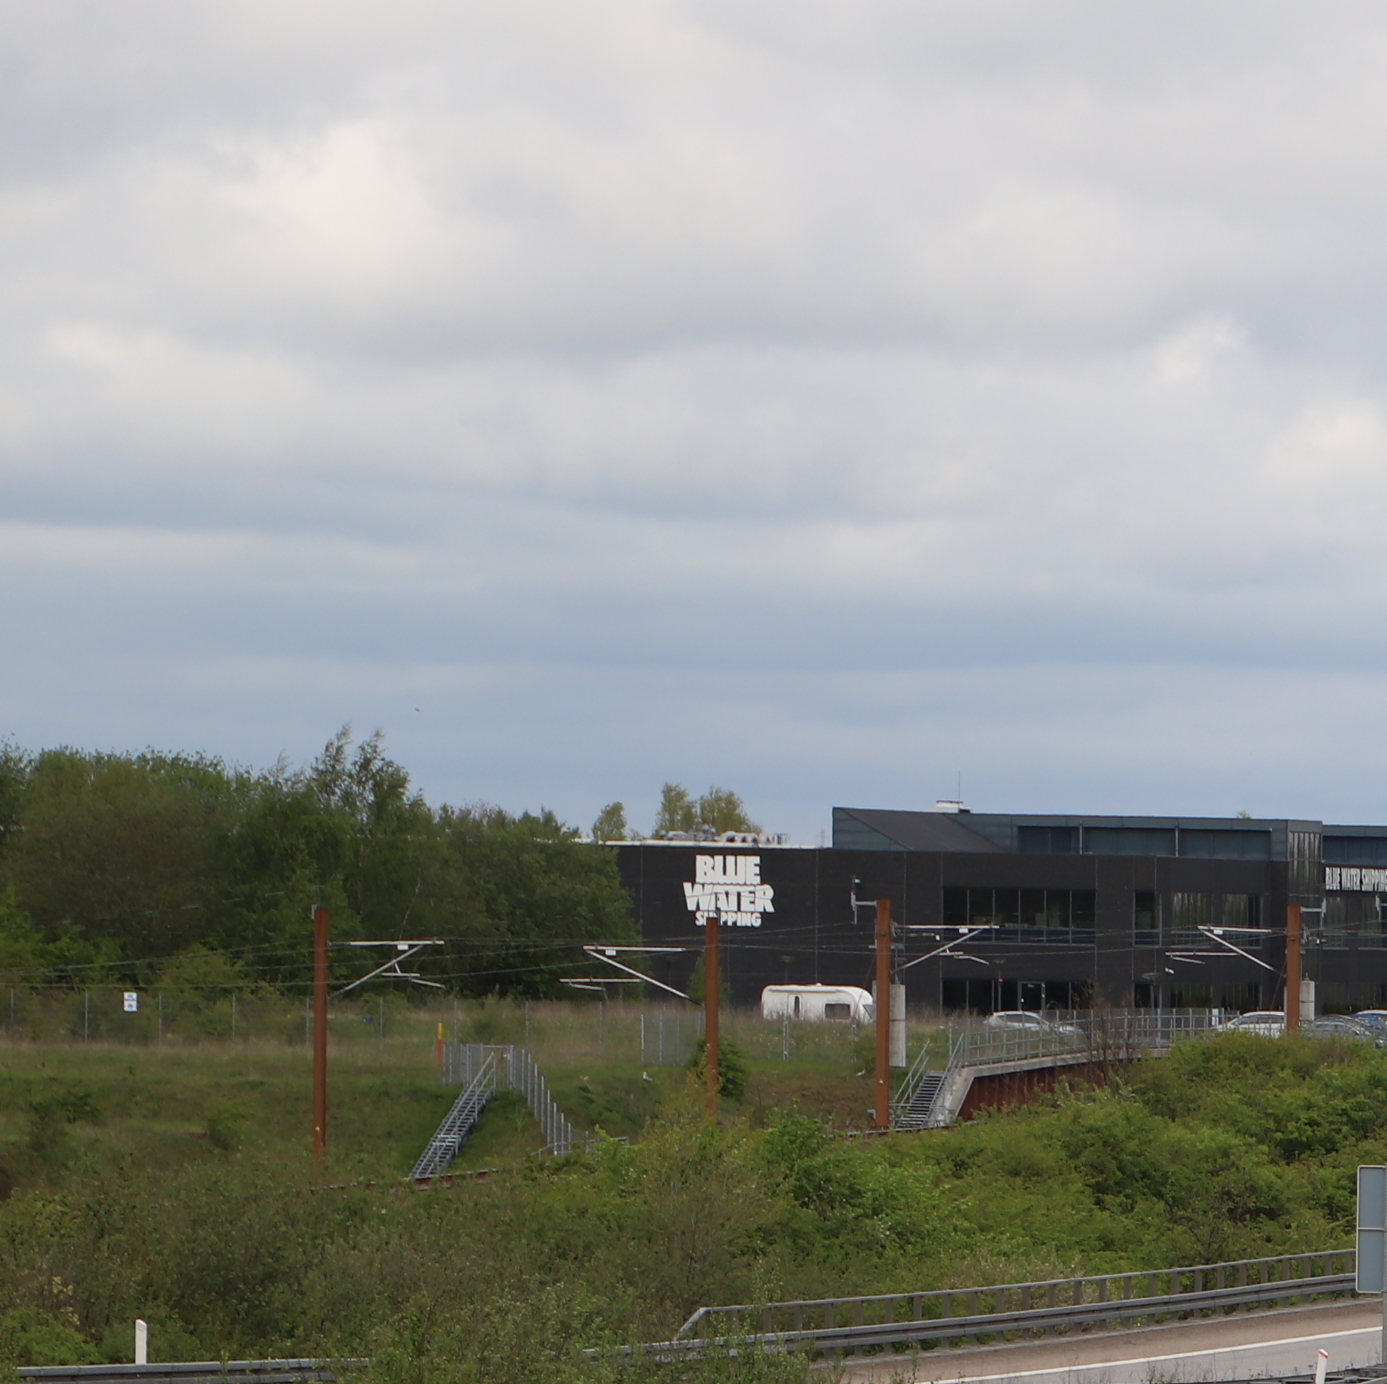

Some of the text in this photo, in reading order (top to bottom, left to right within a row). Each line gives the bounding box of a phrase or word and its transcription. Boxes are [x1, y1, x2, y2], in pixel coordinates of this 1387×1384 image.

[695, 854, 761, 884] BLUE
[1325, 867, 1340, 890] BLUE
[1341, 867, 1360, 890] WATER
[683, 881, 775, 912] WATER
